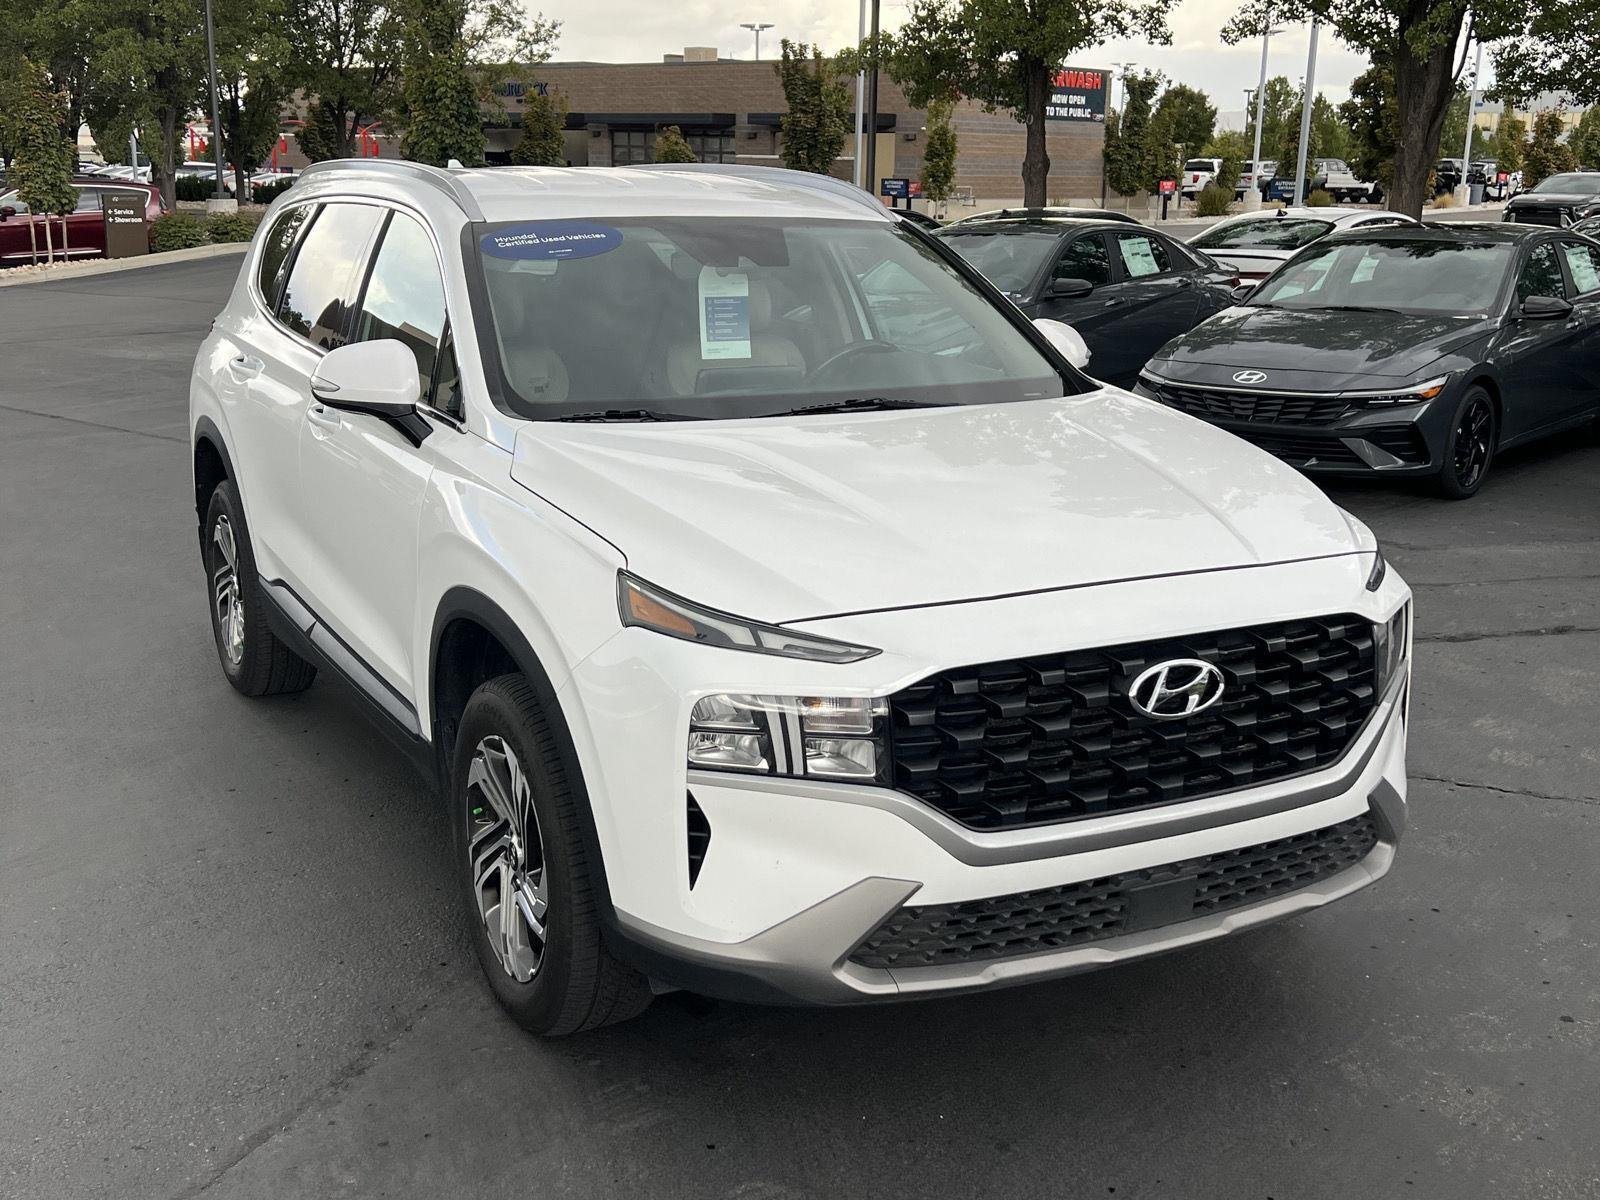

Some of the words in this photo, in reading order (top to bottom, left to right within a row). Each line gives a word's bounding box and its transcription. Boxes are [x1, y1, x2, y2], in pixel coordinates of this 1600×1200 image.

[1056, 70, 1102, 89] RWASH
[1051, 94, 1068, 104] NOW
[1068, 95, 1086, 105] OPEN
[1045, 106, 1055, 116] TO
[1055, 107, 1068, 117] THE
[1068, 108, 1091, 118] PUBLIC
[494, 232, 537, 243] Hyundai
[498, 238, 540, 248] Certified
[540, 235, 565, 243] Used
[565, 233, 606, 241] Vehicles
